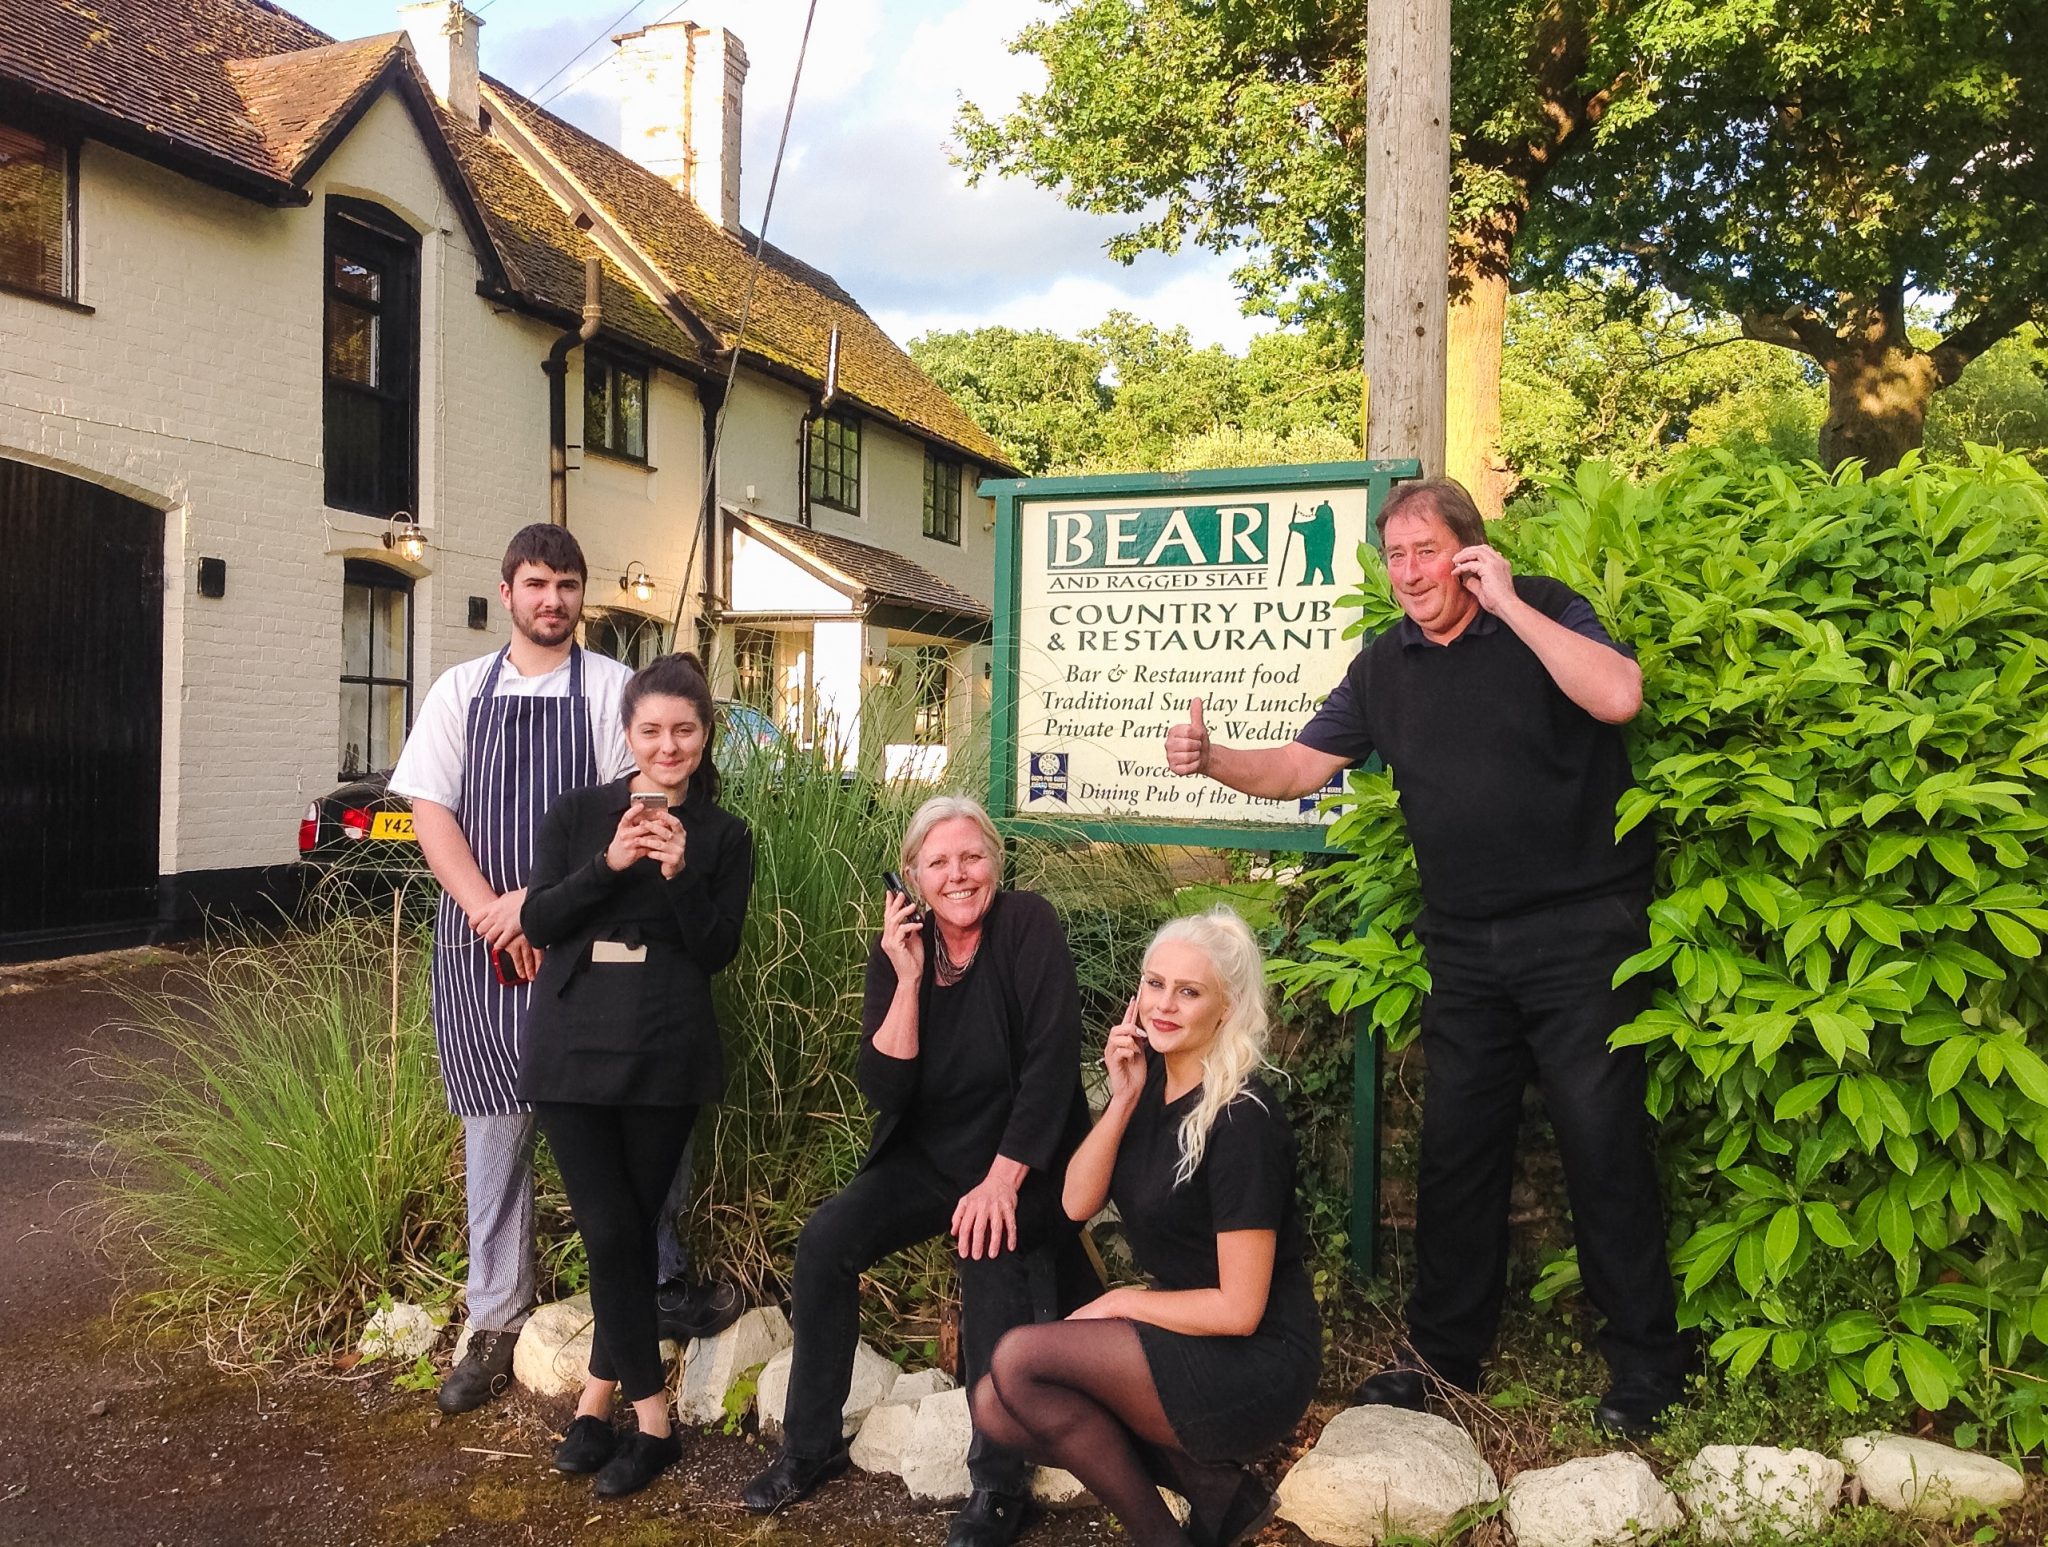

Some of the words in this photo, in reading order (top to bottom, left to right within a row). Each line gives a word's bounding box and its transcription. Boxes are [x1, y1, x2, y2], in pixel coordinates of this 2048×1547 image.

[1050, 507, 1264, 567] BEAR
[1050, 576, 1099, 590] AND
[1107, 574, 1198, 590] RAGGED
[1205, 572, 1267, 587] STAFF
[1049, 602, 1238, 626] COUNTRY
[1253, 600, 1331, 624] PUB
[1047, 631, 1065, 651] &
[1078, 627, 1337, 652] RESTAURANT
[1065, 664, 1102, 683] Bar
[1107, 663, 1128, 683] &
[1134, 664, 1246, 684] Restaurant
[1251, 663, 1301, 688] food
[1042, 690, 1152, 711] Traditional
[1244, 692, 1325, 713] Lunche
[1044, 718, 1114, 739] Private
[1120, 719, 1170, 739] Parti
[1080, 783, 1140, 806] Dining
[1145, 785, 1180, 803] Pub
[1185, 785, 1207, 808] of
[1209, 786, 1237, 805] the
[384, 818, 415, 833] Y42
